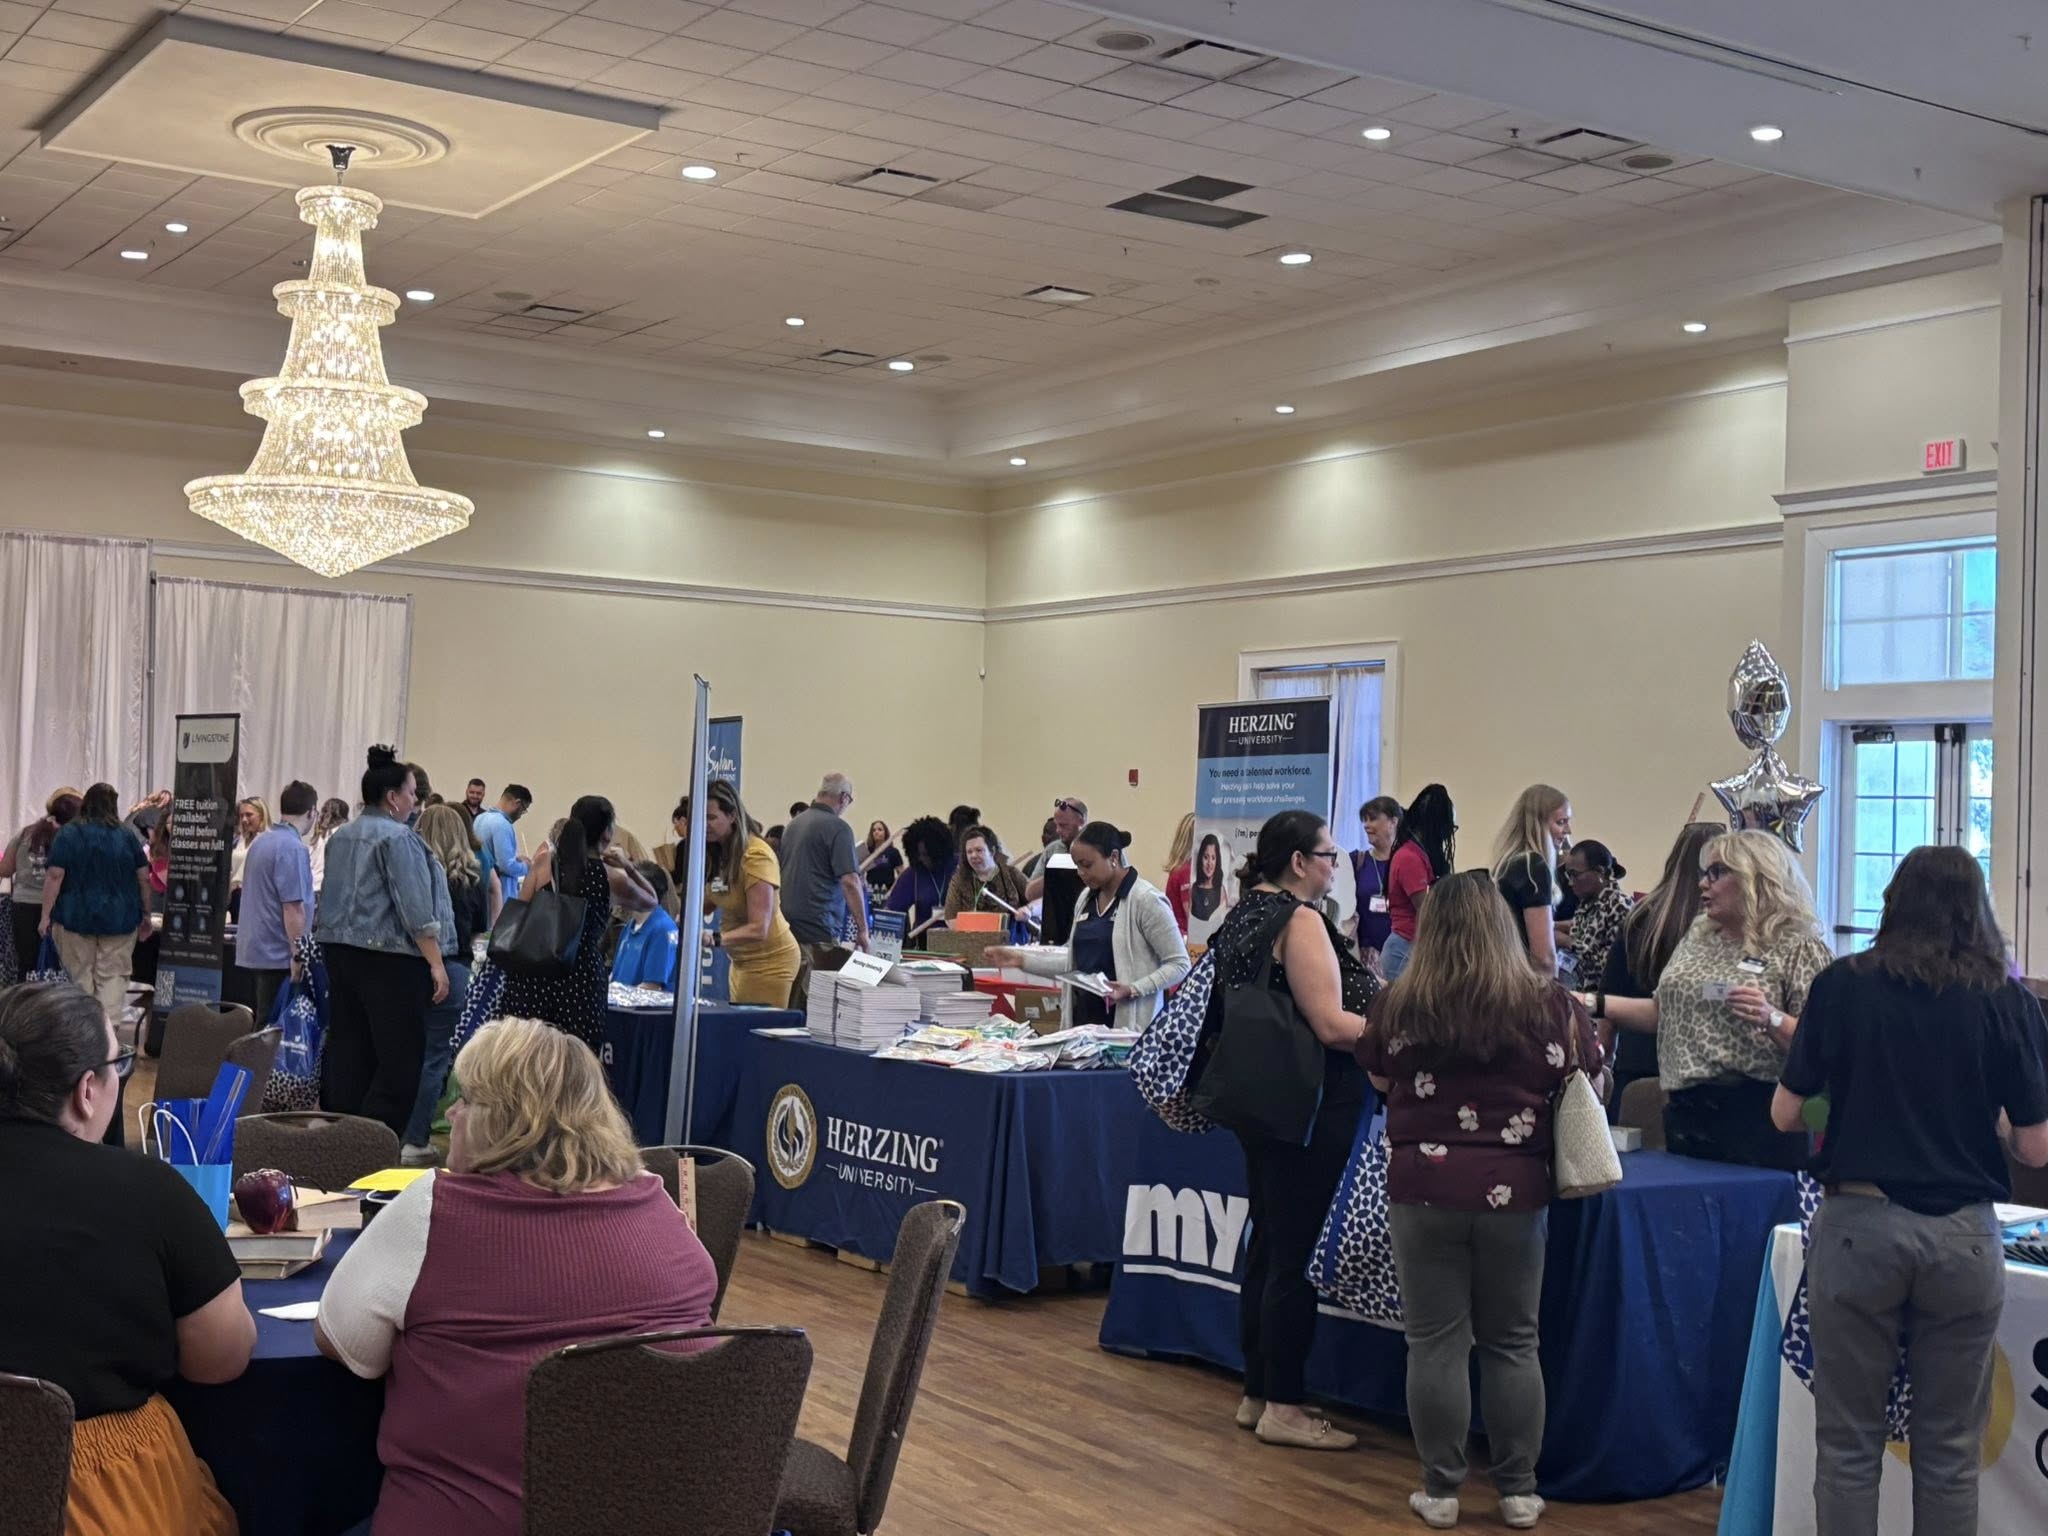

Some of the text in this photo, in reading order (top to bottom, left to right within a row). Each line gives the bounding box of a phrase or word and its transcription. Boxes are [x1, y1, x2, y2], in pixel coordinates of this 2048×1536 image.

[1926, 440, 1953, 468] EXIT
[1228, 713, 1296, 734] HERZING
[191, 732, 230, 744] LIVINGSTONE
[1238, 735, 1283, 745] UNIVERSITY
[1209, 768, 1222, 778] You
[1222, 767, 1239, 777] need
[1246, 767, 1273, 777] talented
[1274, 765, 1312, 776] workforce.
[1282, 782, 1295, 791] your
[175, 799, 218, 810] FREE tuition
[172, 825, 217, 837] Enroll before
[171, 838, 225, 850] classes are full!
[826, 1116, 941, 1174] HERZING
[838, 1162, 916, 1196] UNIVERSITY
[1123, 1182, 1253, 1274] my
